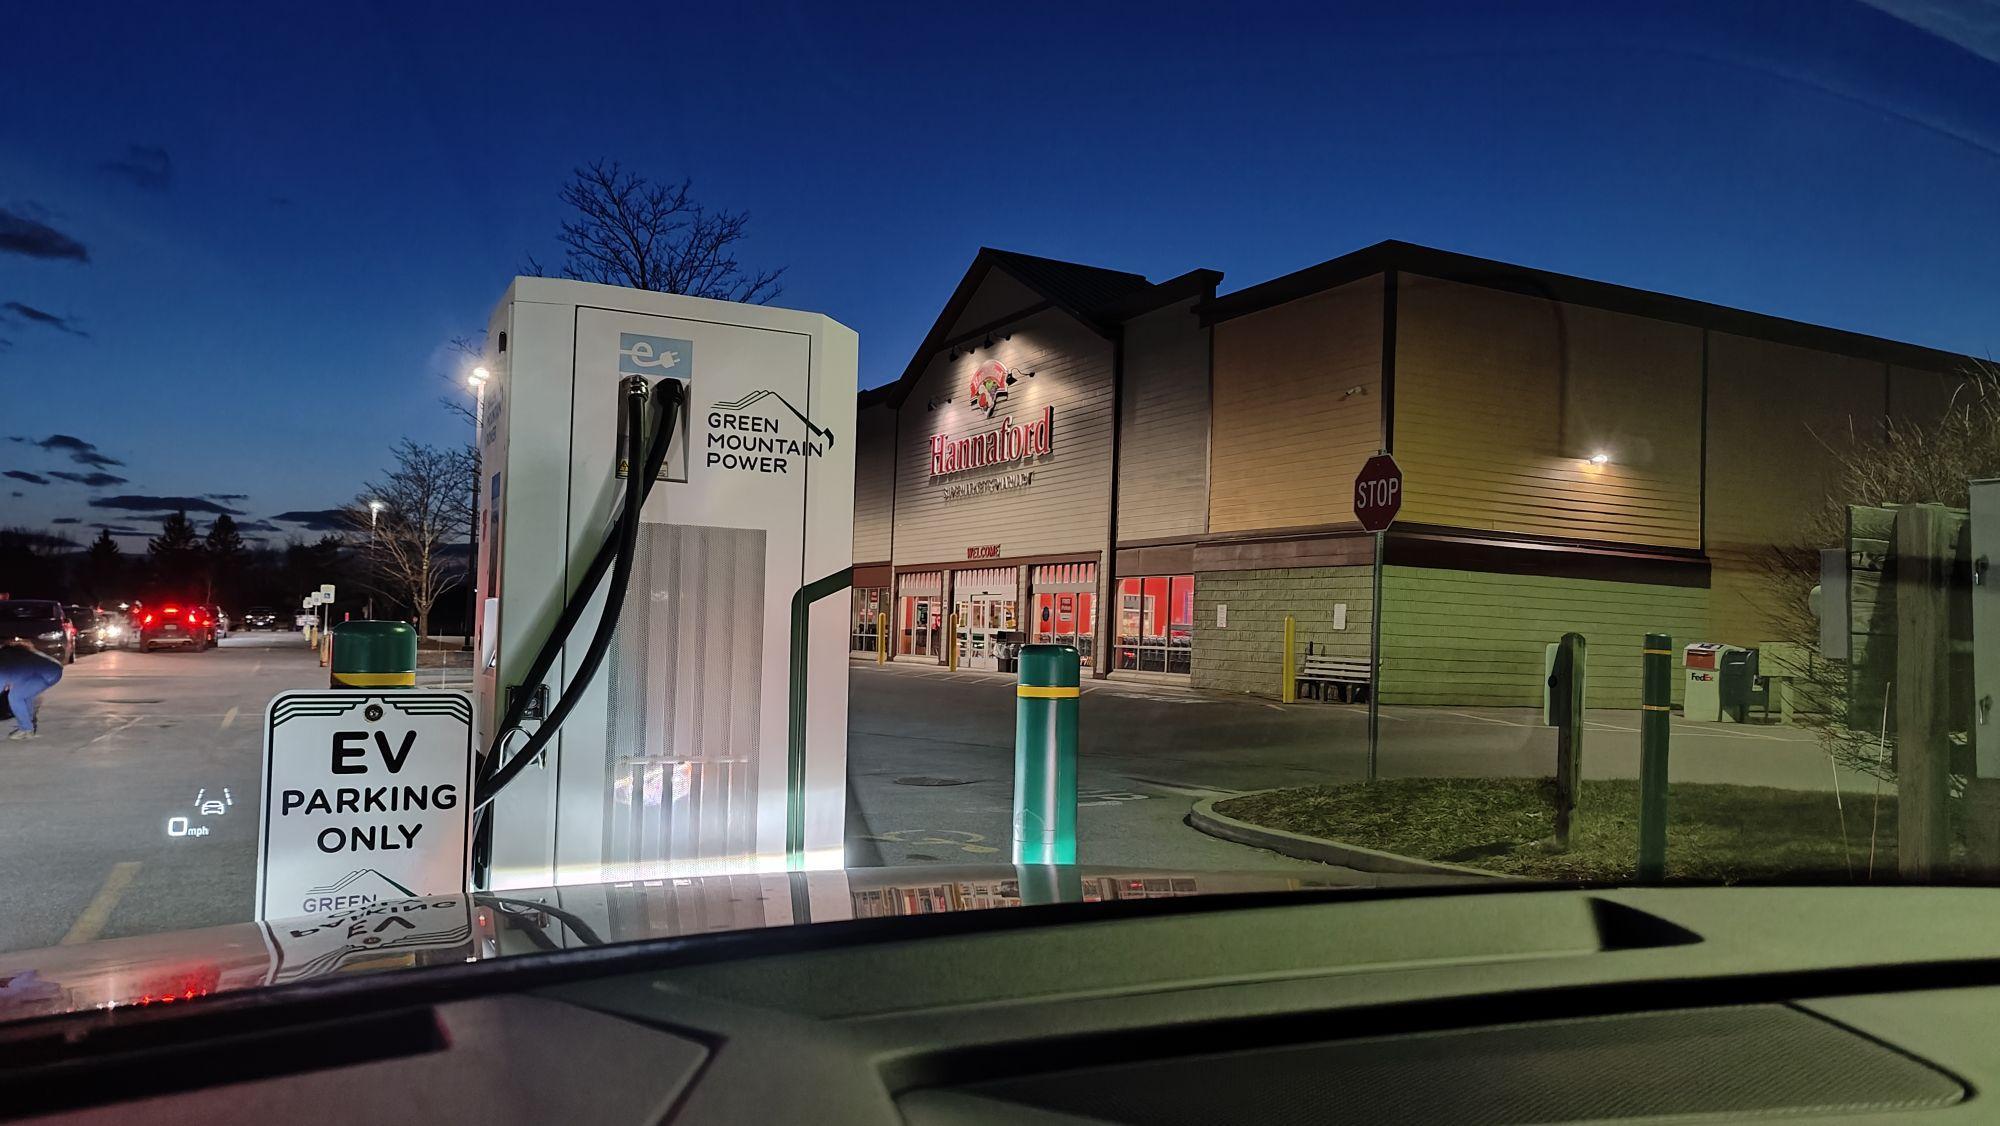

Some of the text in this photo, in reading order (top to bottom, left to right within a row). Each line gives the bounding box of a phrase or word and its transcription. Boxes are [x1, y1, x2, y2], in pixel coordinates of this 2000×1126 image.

[707, 412, 779, 434] GREEN
[707, 432, 823, 458] MOUNTAIN
[929, 405, 1053, 477] Hannaford
[706, 452, 788, 474] POWER
[1357, 477, 1399, 509] STOP
[967, 544, 1001, 559] WELCOME
[1691, 672, 1713, 682] FedEx
[331, 730, 417, 775] EV
[282, 784, 457, 816] PARKING
[187, 825, 209, 838] mph
[317, 823, 423, 854] ONLY
